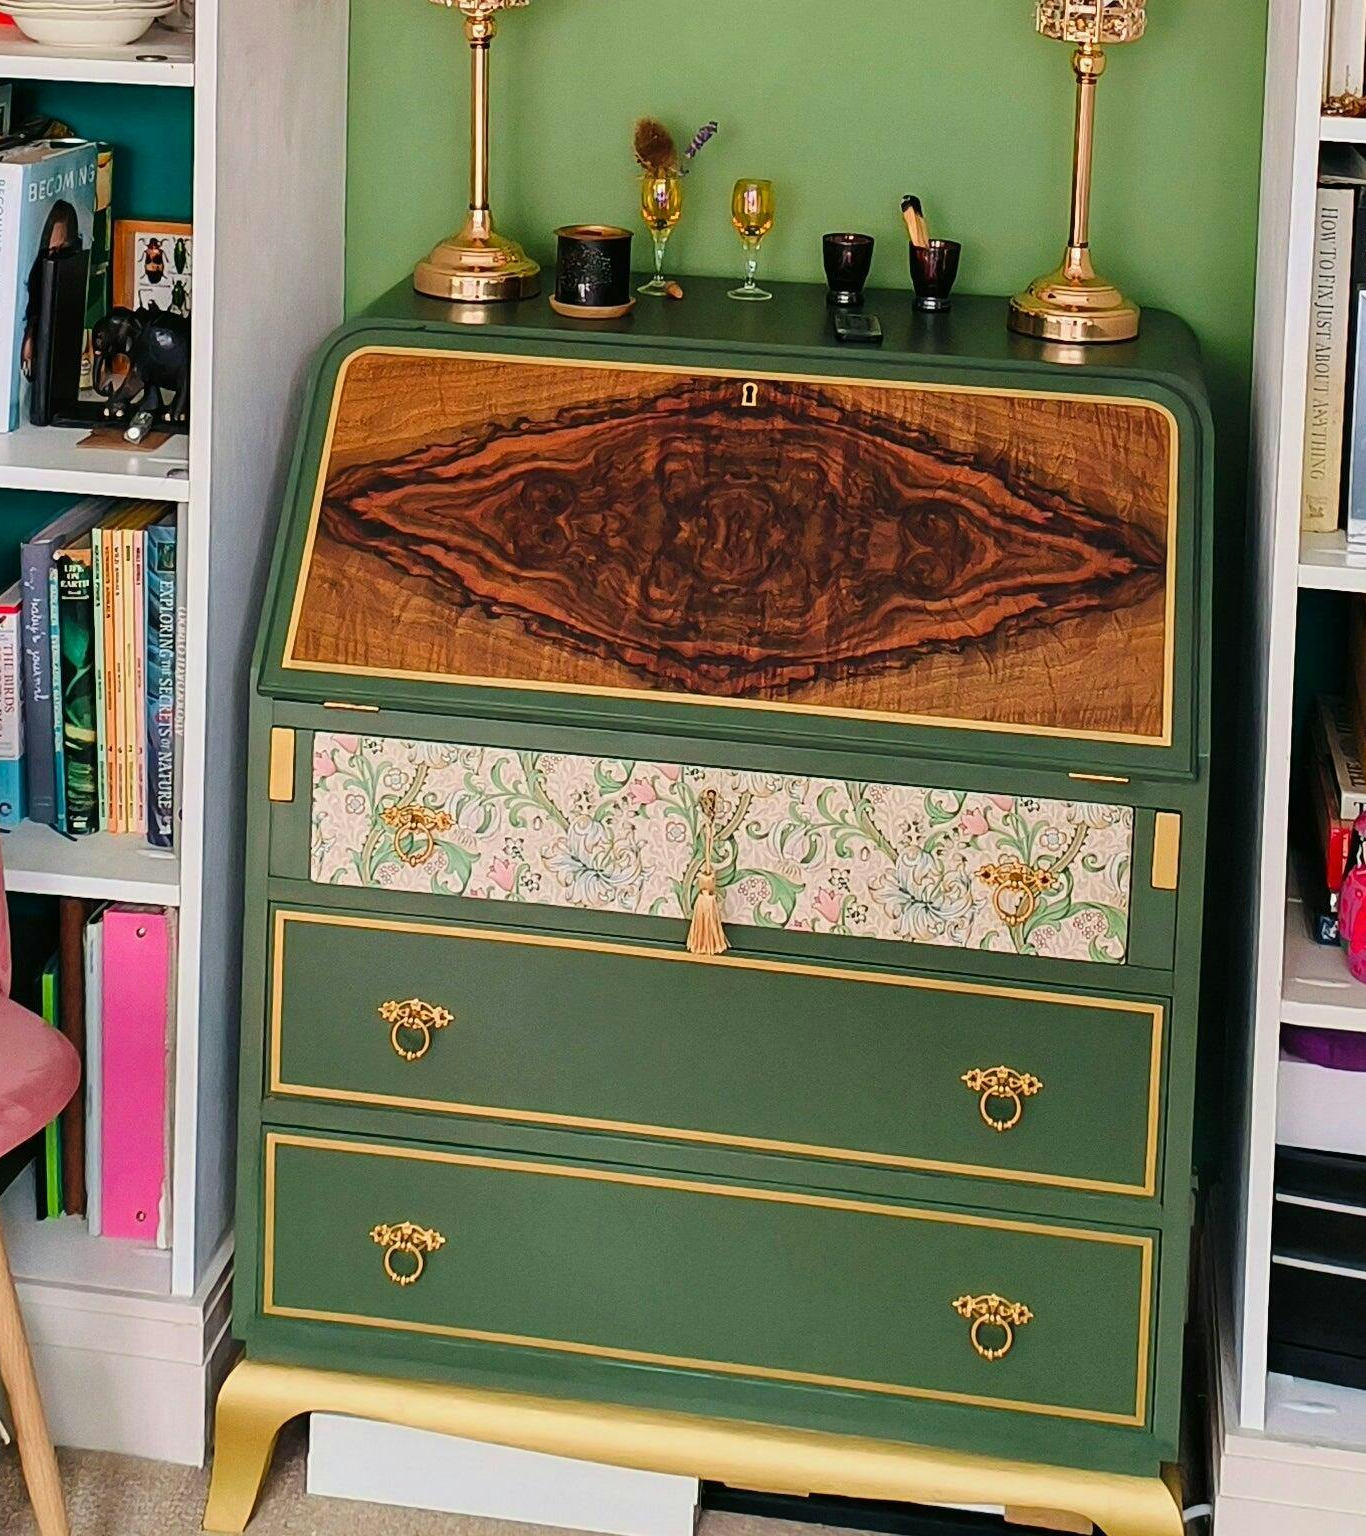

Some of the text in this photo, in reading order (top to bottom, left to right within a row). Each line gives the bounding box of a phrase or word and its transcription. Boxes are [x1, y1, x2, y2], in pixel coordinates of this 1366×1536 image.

[27, 163, 96, 203] BECOMING
[3, 643, 15, 714] THE BIRDS
[157, 579, 175, 809] EXPLORING SECRETS NATURE
